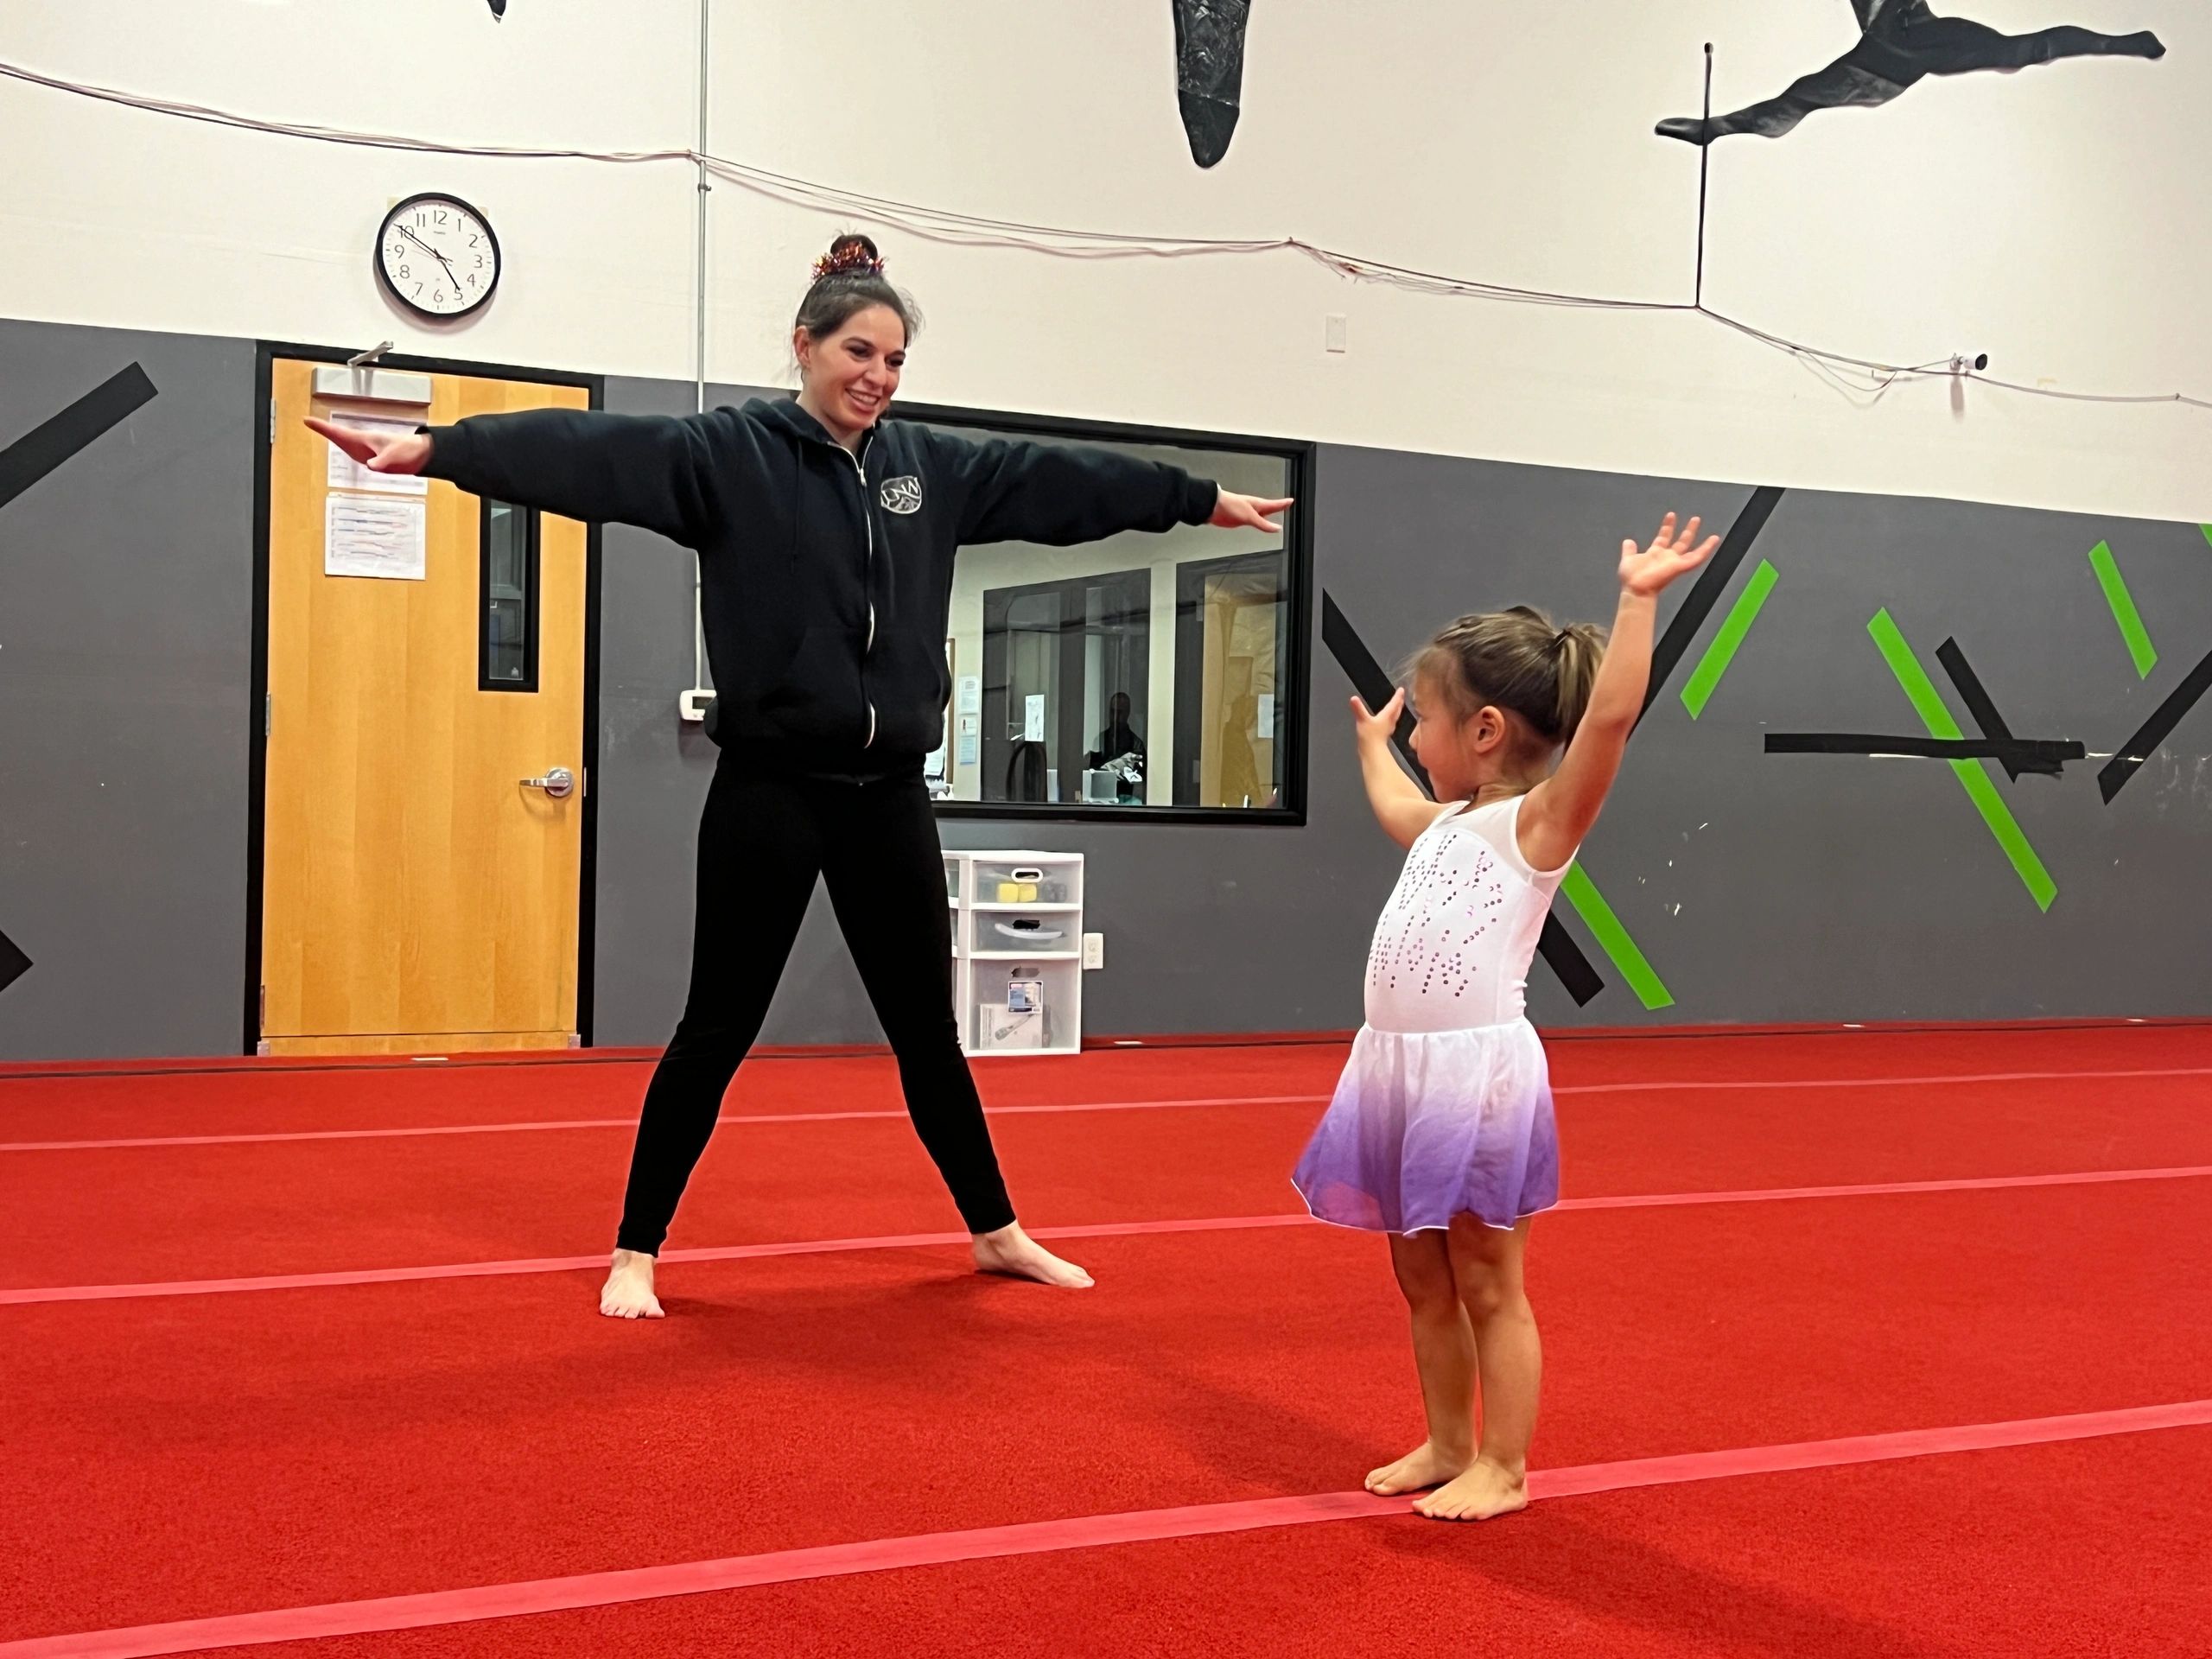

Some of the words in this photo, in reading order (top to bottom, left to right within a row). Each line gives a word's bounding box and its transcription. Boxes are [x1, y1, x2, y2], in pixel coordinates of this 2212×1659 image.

[416, 213, 426, 227] 11
[434, 210, 448, 225] 12
[457, 218, 461, 232] 1
[468, 233, 479, 248] 2
[394, 245, 404, 258] 9
[474, 254, 483, 269] 3
[399, 264, 410, 279] 8
[467, 273, 476, 287] 4
[415, 282, 423, 296] 7
[433, 289, 443, 302] 6
[454, 287, 463, 301] 5
